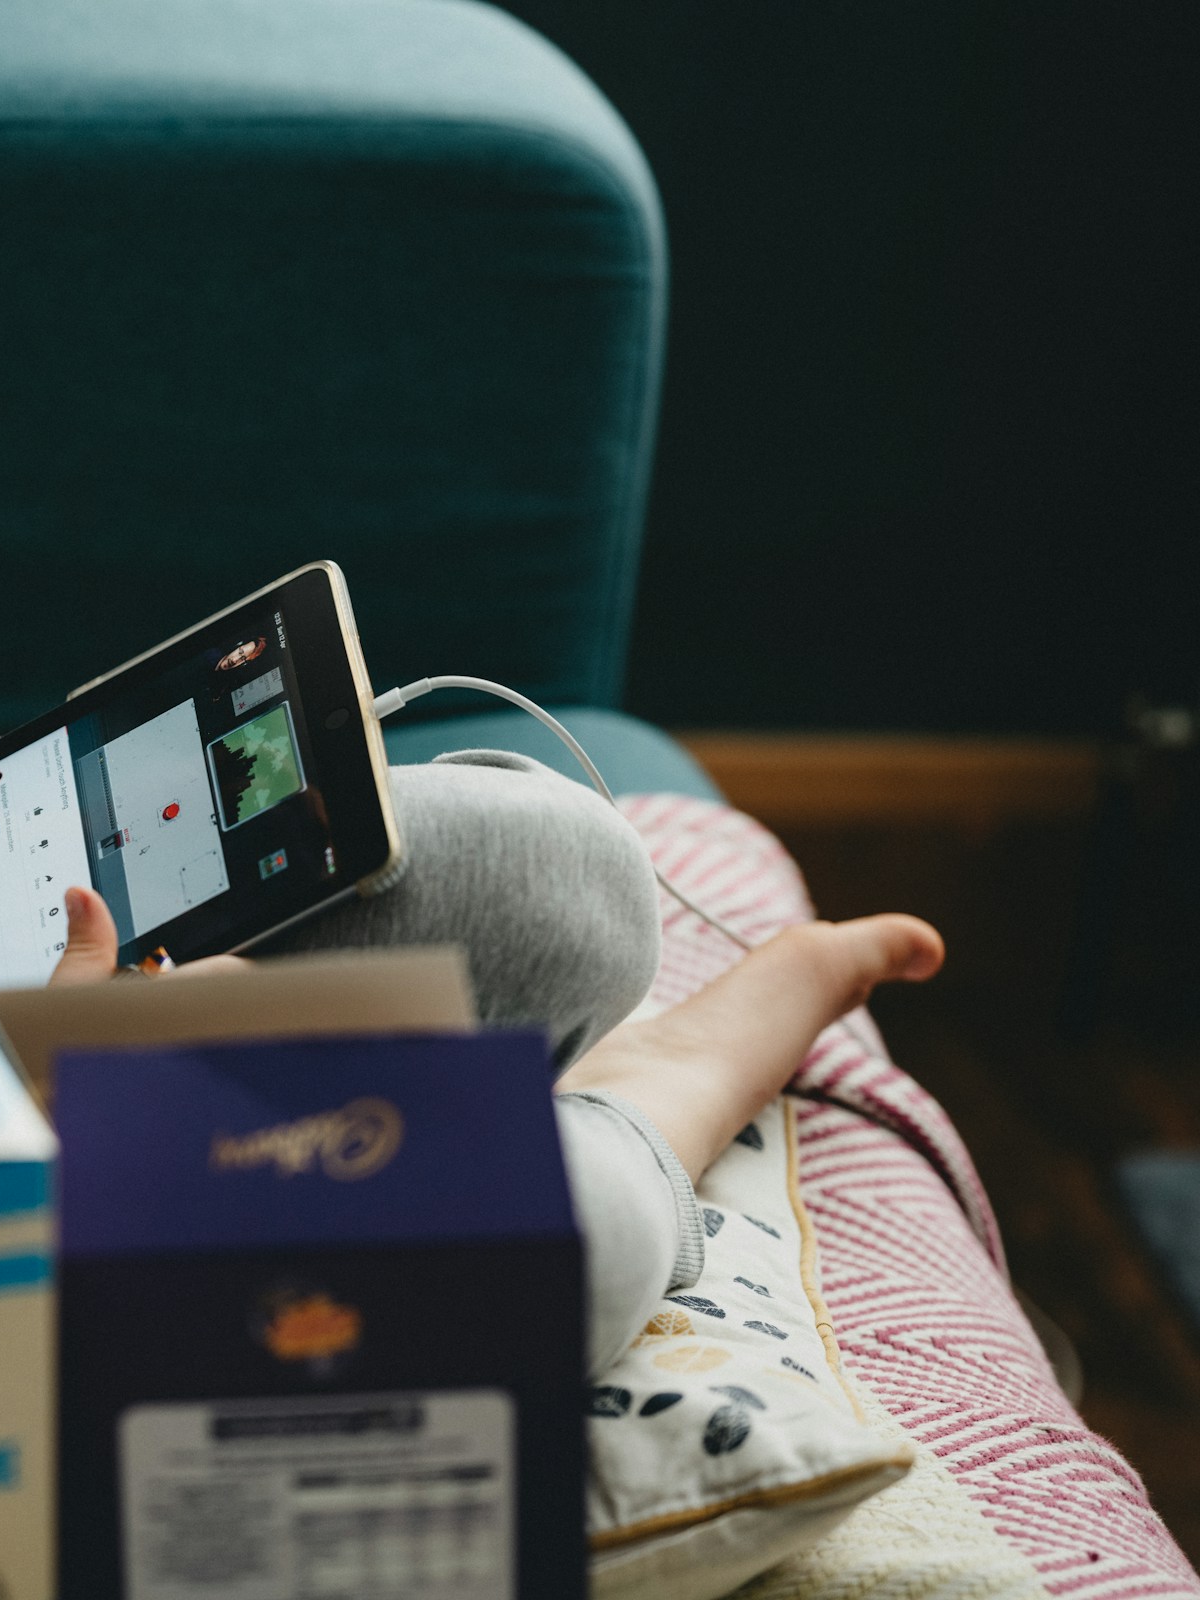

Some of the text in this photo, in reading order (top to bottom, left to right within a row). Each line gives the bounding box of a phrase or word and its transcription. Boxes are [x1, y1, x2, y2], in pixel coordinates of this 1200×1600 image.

[58, 770, 66, 785] Touch
[60, 786, 69, 810] Anything
[0, 783, 8, 809] Markiplier
[6, 825, 14, 853] subscribers
